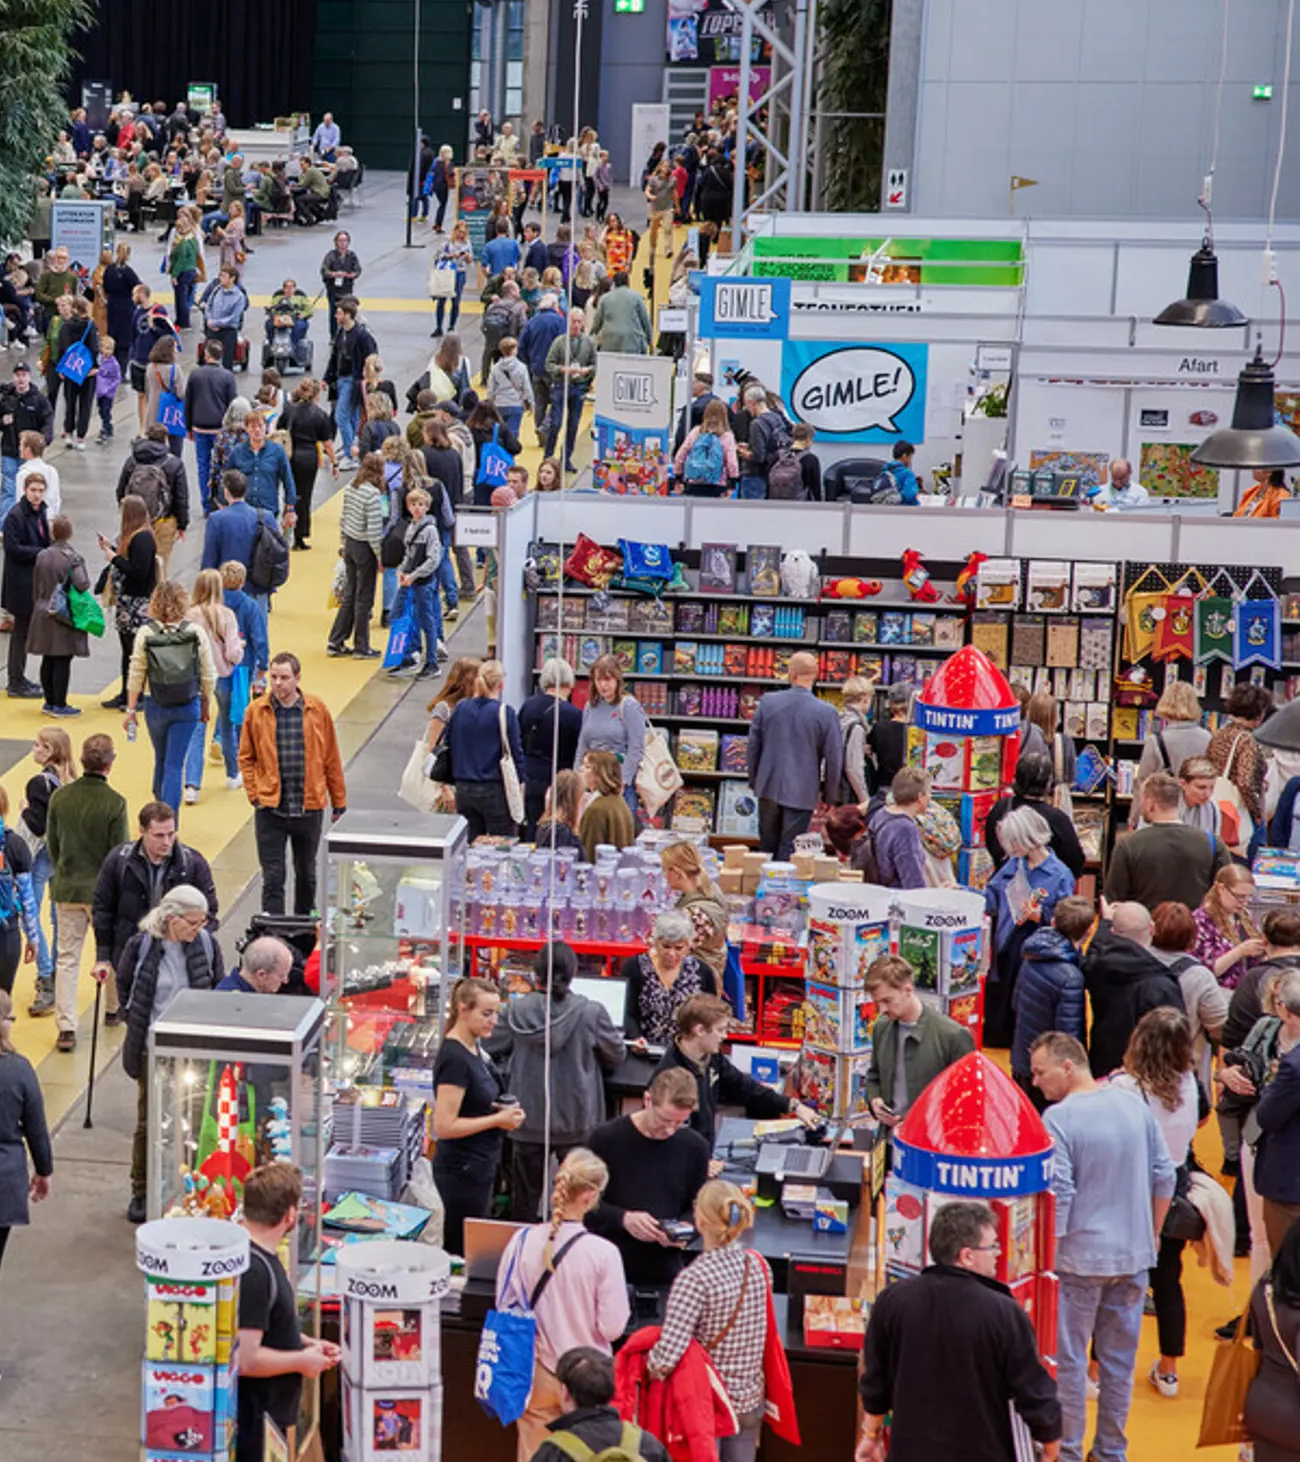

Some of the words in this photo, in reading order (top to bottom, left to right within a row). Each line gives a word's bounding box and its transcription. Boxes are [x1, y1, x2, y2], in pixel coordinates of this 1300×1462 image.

[718, 286, 769, 320] GIMLE
[1179, 357, 1219, 373] Afart
[616, 375, 649, 402] GIMLE
[802, 367, 902, 411] GIMLE!
[925, 709, 974, 730] TINTIN
[827, 907, 870, 921] ZOOM
[925, 915, 967, 928] ZOOM
[936, 1161, 1020, 1190] TINTIN
[138, 1250, 169, 1274] OOM
[201, 1255, 245, 1277] ZOOM
[347, 1277, 399, 1299] ZOOM
[153, 1370, 204, 1385] VIGGO
